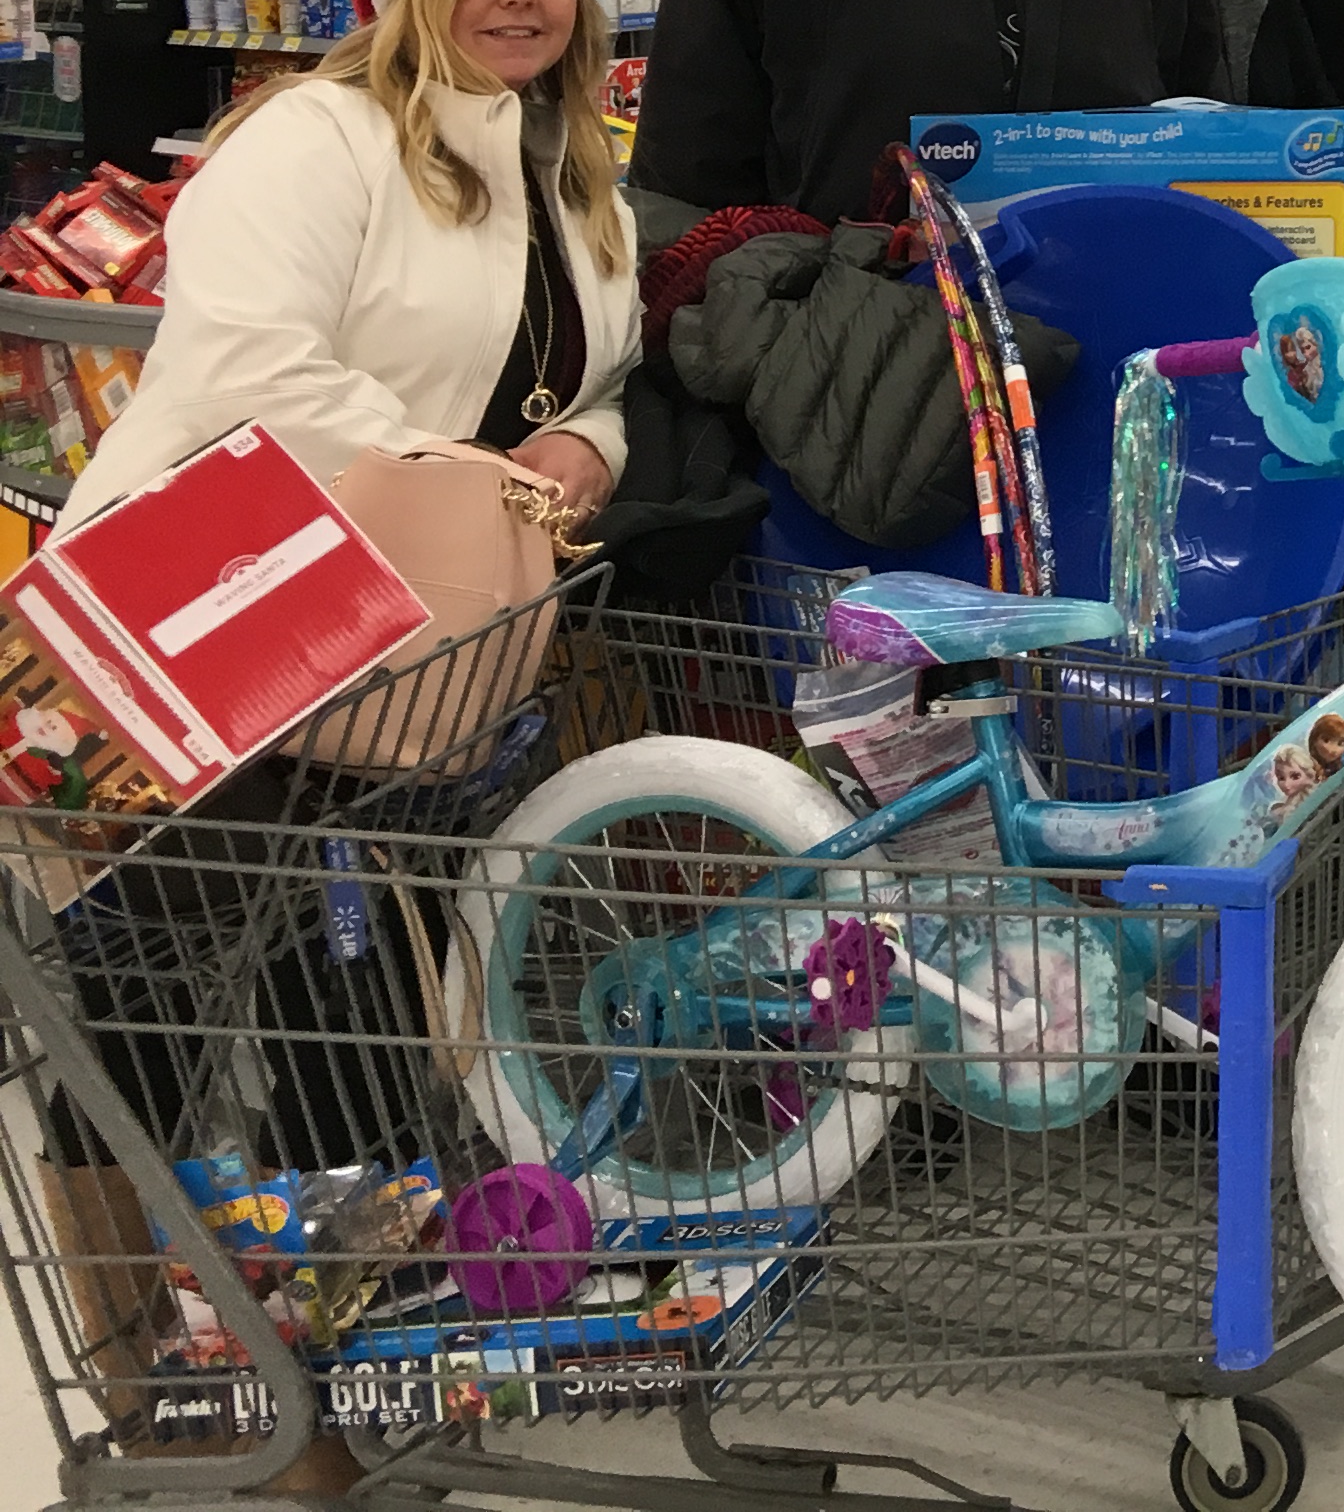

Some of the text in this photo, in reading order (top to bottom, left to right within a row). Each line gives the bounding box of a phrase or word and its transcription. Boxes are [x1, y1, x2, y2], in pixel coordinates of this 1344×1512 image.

[1036, 122, 1051, 139] to
[1054, 125, 1085, 141] grow
[1088, 124, 1117, 145] with
[1118, 131, 1150, 148] your
[1152, 121, 1184, 142] child
[919, 140, 976, 161] vtech
[1253, 196, 1262, 208] &
[1265, 195, 1324, 209] Features
